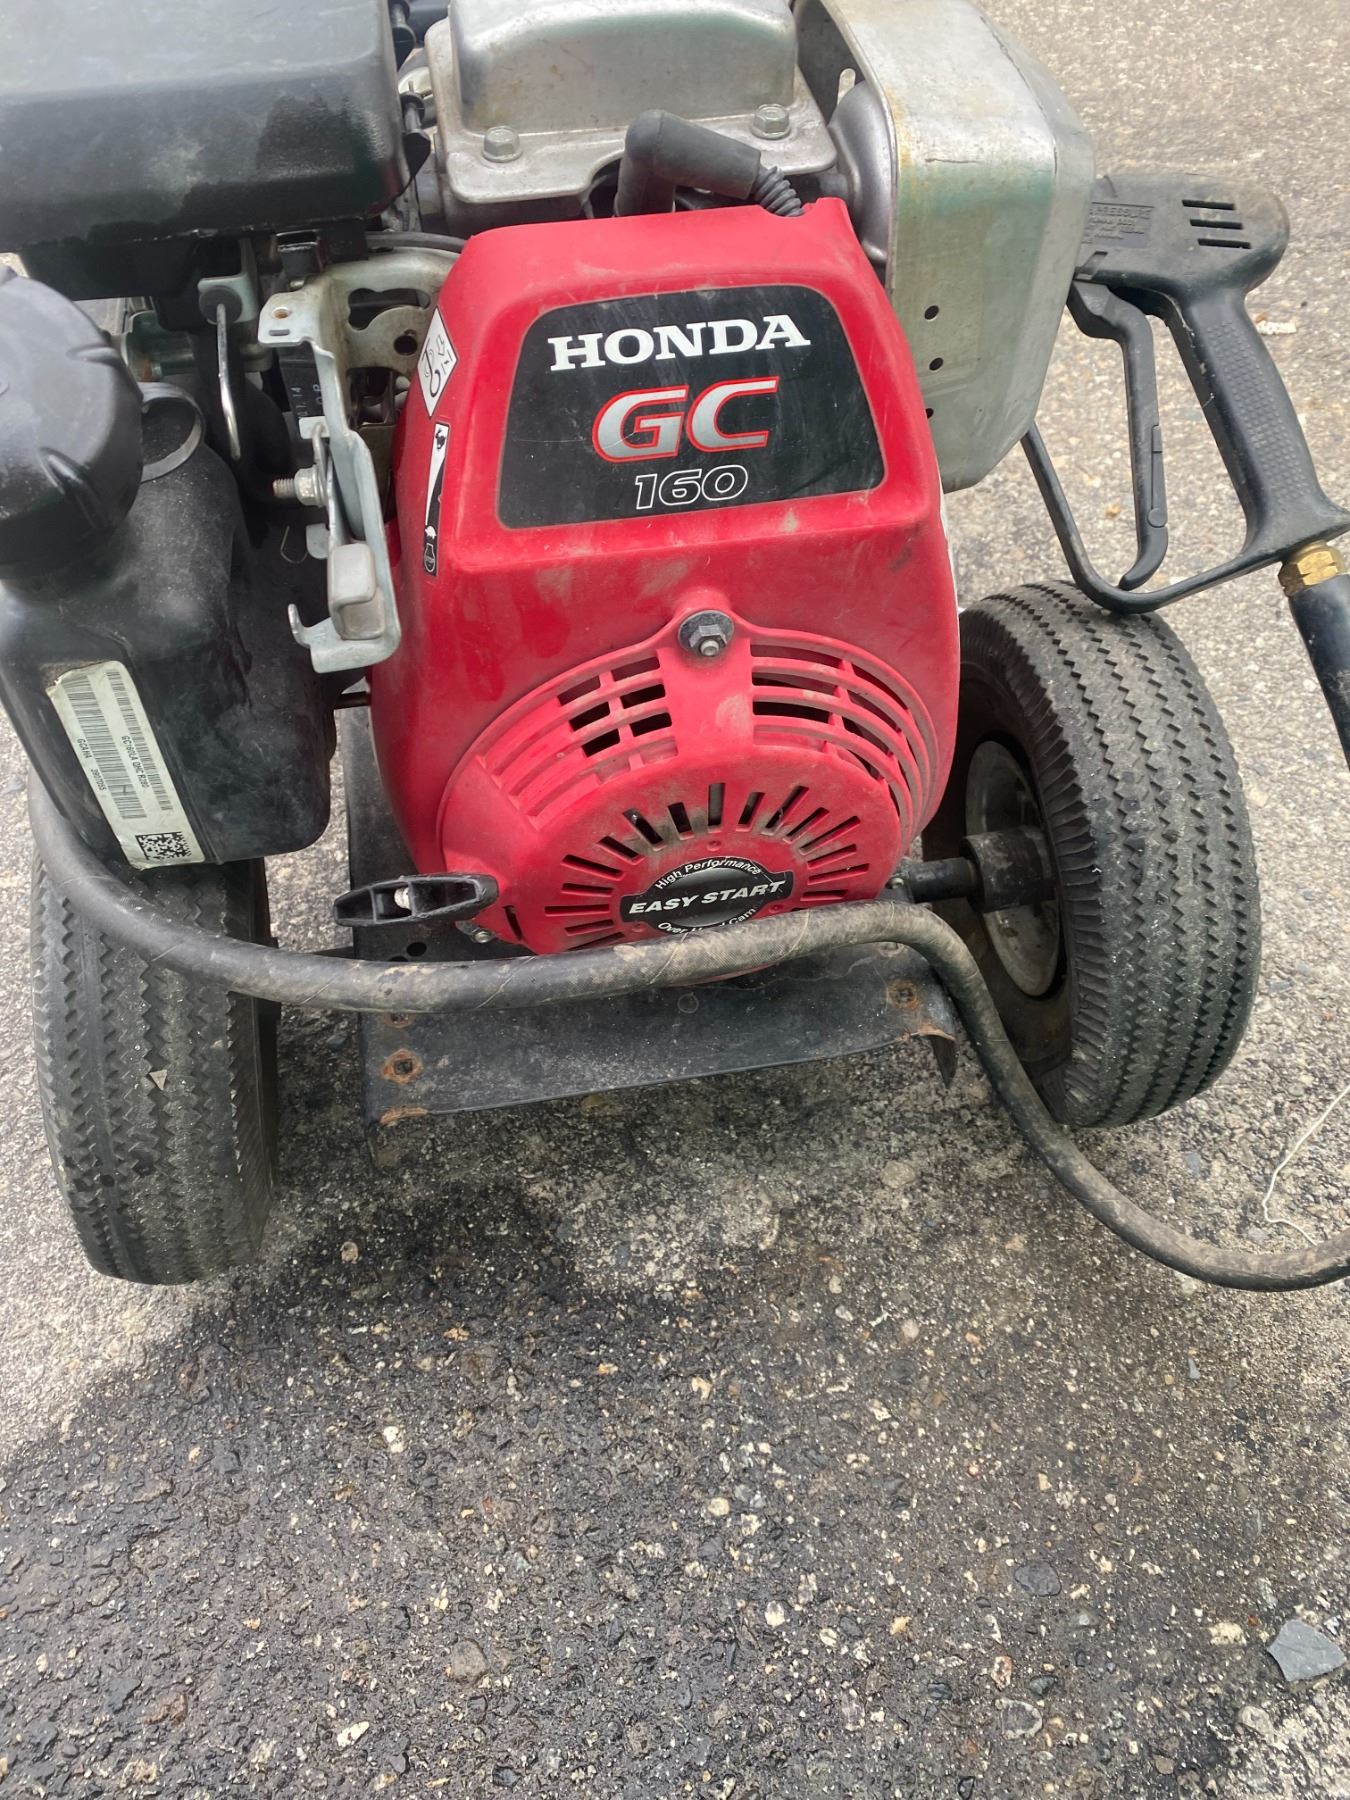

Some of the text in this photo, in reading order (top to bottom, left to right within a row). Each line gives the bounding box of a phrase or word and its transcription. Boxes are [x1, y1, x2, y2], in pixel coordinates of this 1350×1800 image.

[547, 315, 811, 371] HONDA
[592, 376, 780, 463] GC
[635, 465, 748, 510] 160
[655, 859, 761, 889] High Performance
[629, 880, 786, 914] EASY START
[658, 922, 688, 934] Over
[728, 908, 757, 925] Cam
